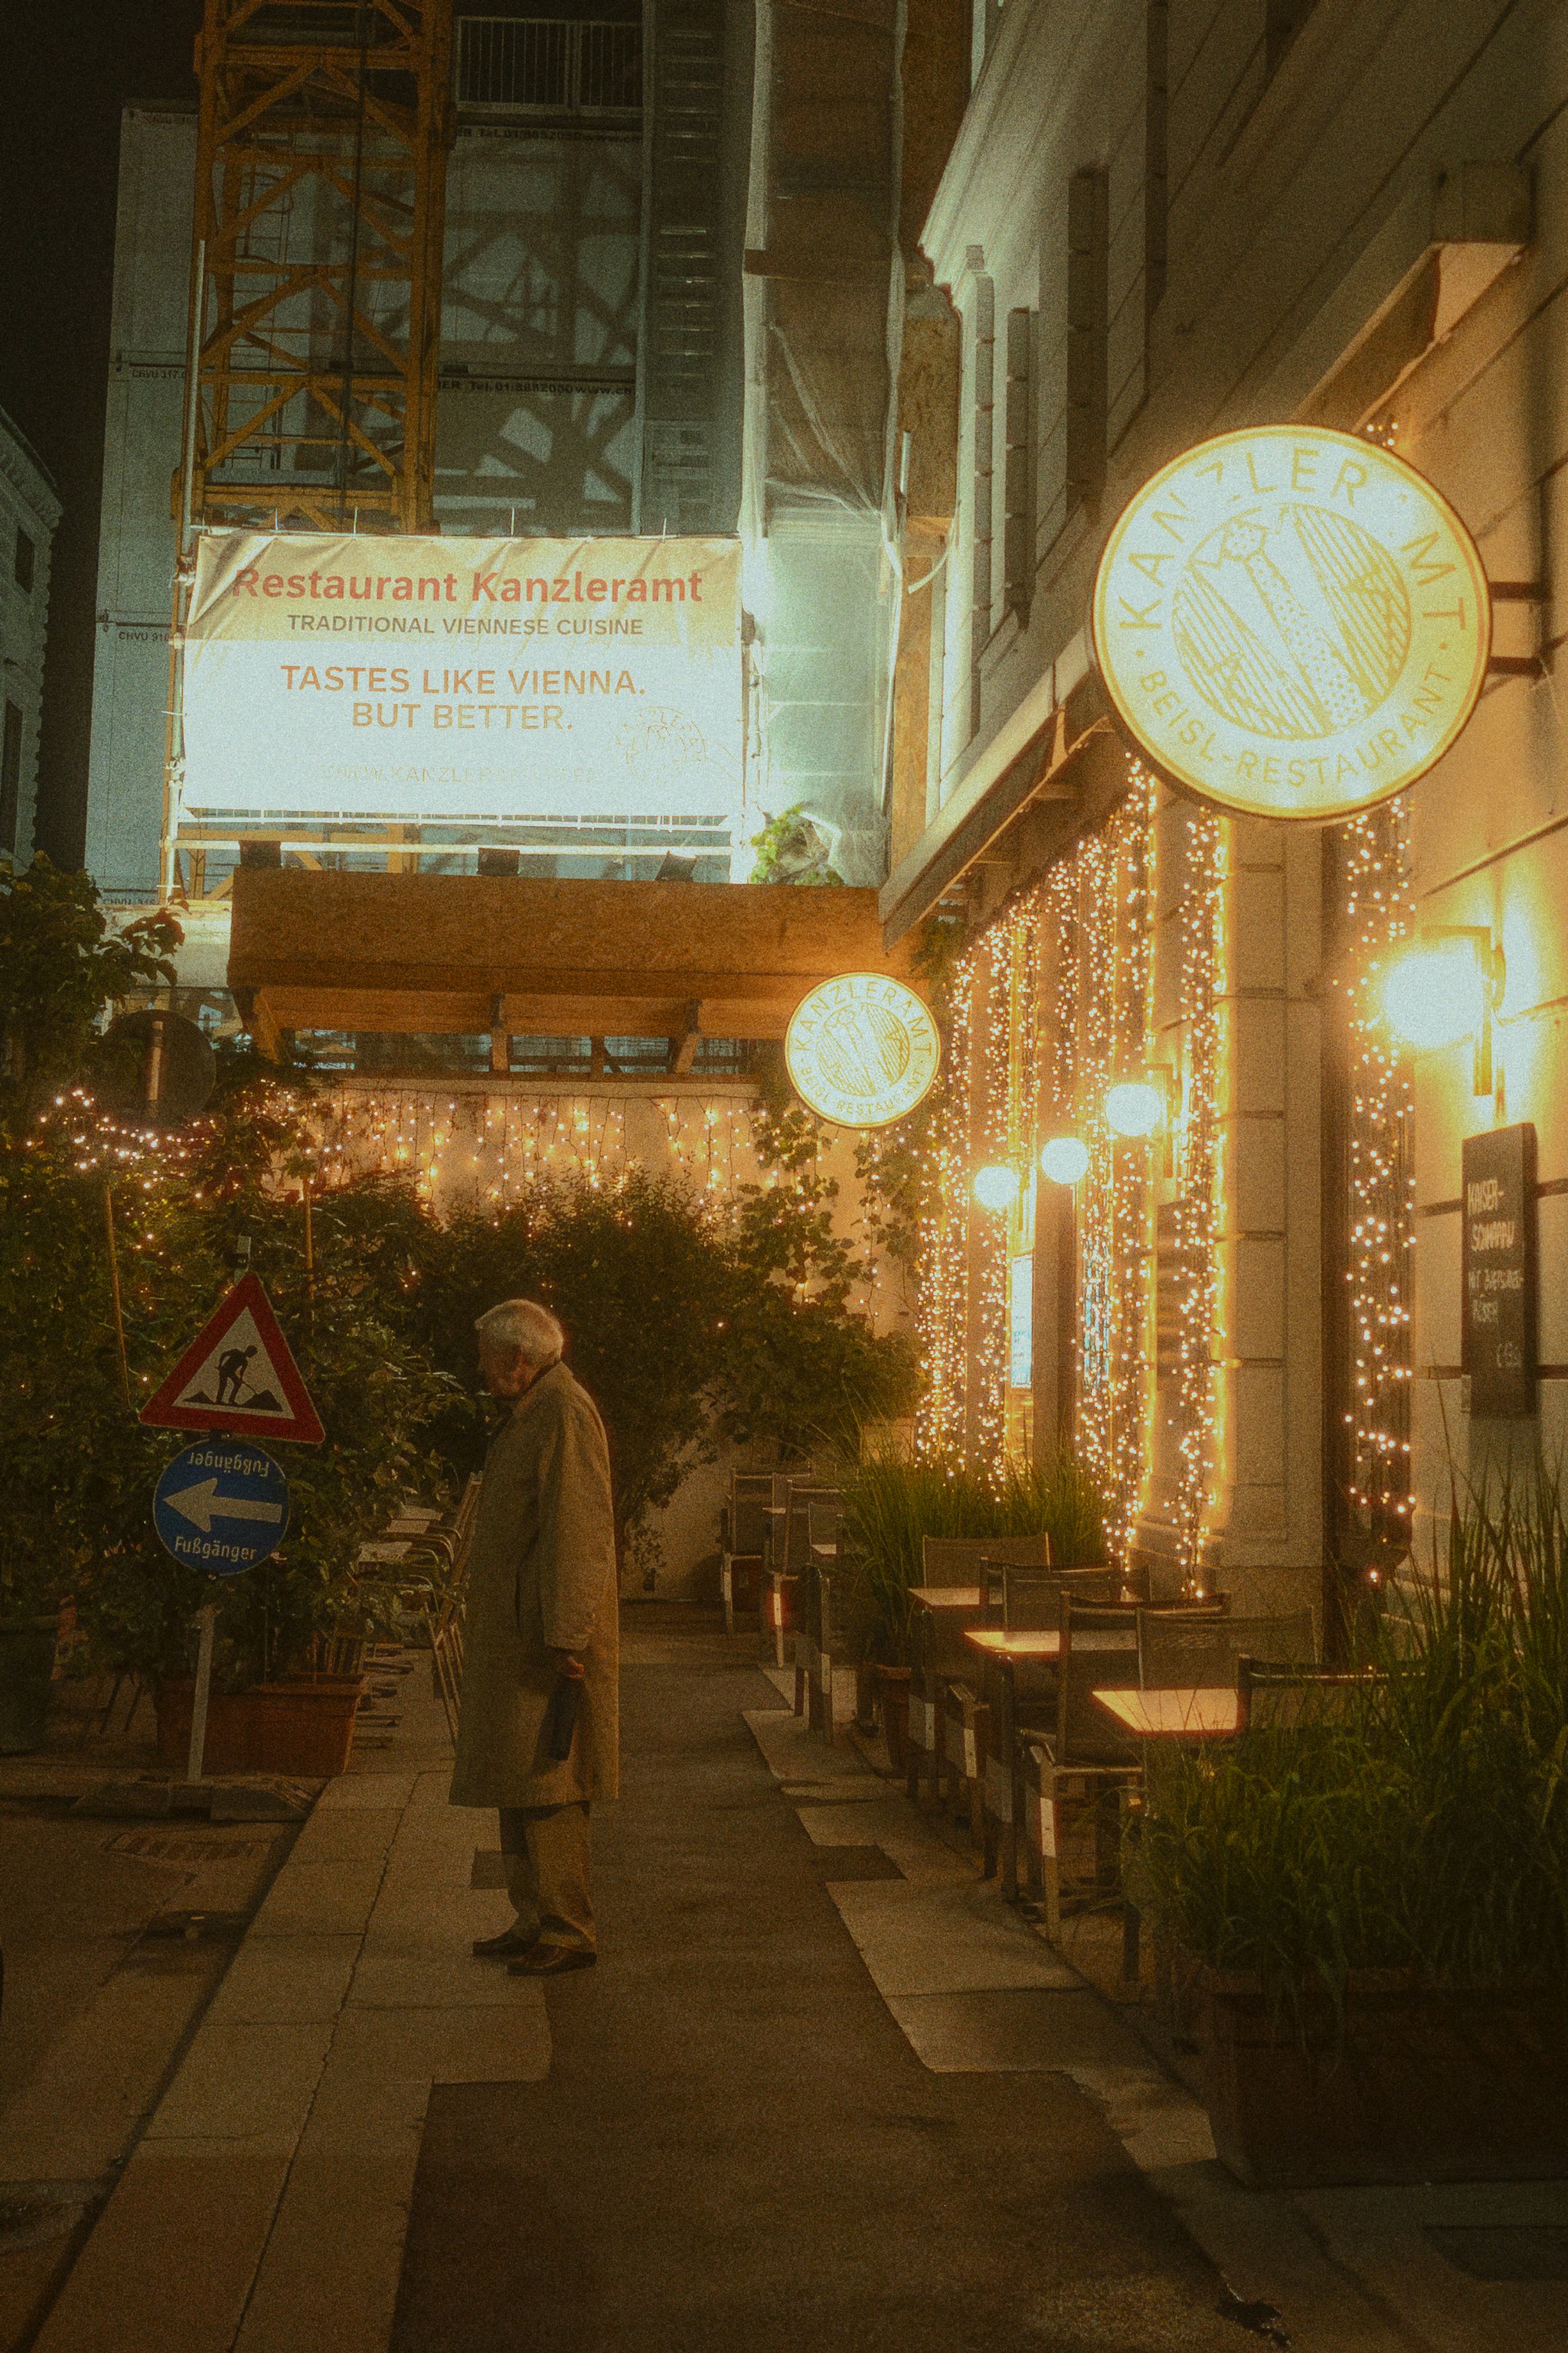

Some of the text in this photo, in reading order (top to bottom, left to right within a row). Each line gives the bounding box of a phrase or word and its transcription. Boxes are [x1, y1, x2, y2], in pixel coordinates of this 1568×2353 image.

[1118, 448, 1466, 631] KANZLERMT
[236, 568, 702, 603] Restaurant Kanzleramt
[287, 614, 644, 636] TRADITIONAL VIENNESE CUISINE
[281, 664, 646, 696] TASTES LIKE VIENNA.
[352, 702, 573, 730] BUT BETTER.
[1140, 662, 1452, 787] BEISL-RESTAURANT
[794, 981, 932, 1056] KANZLERAMT
[187, 1451, 270, 1478] Fußgänger
[174, 1536, 258, 1563] Fußgänger
